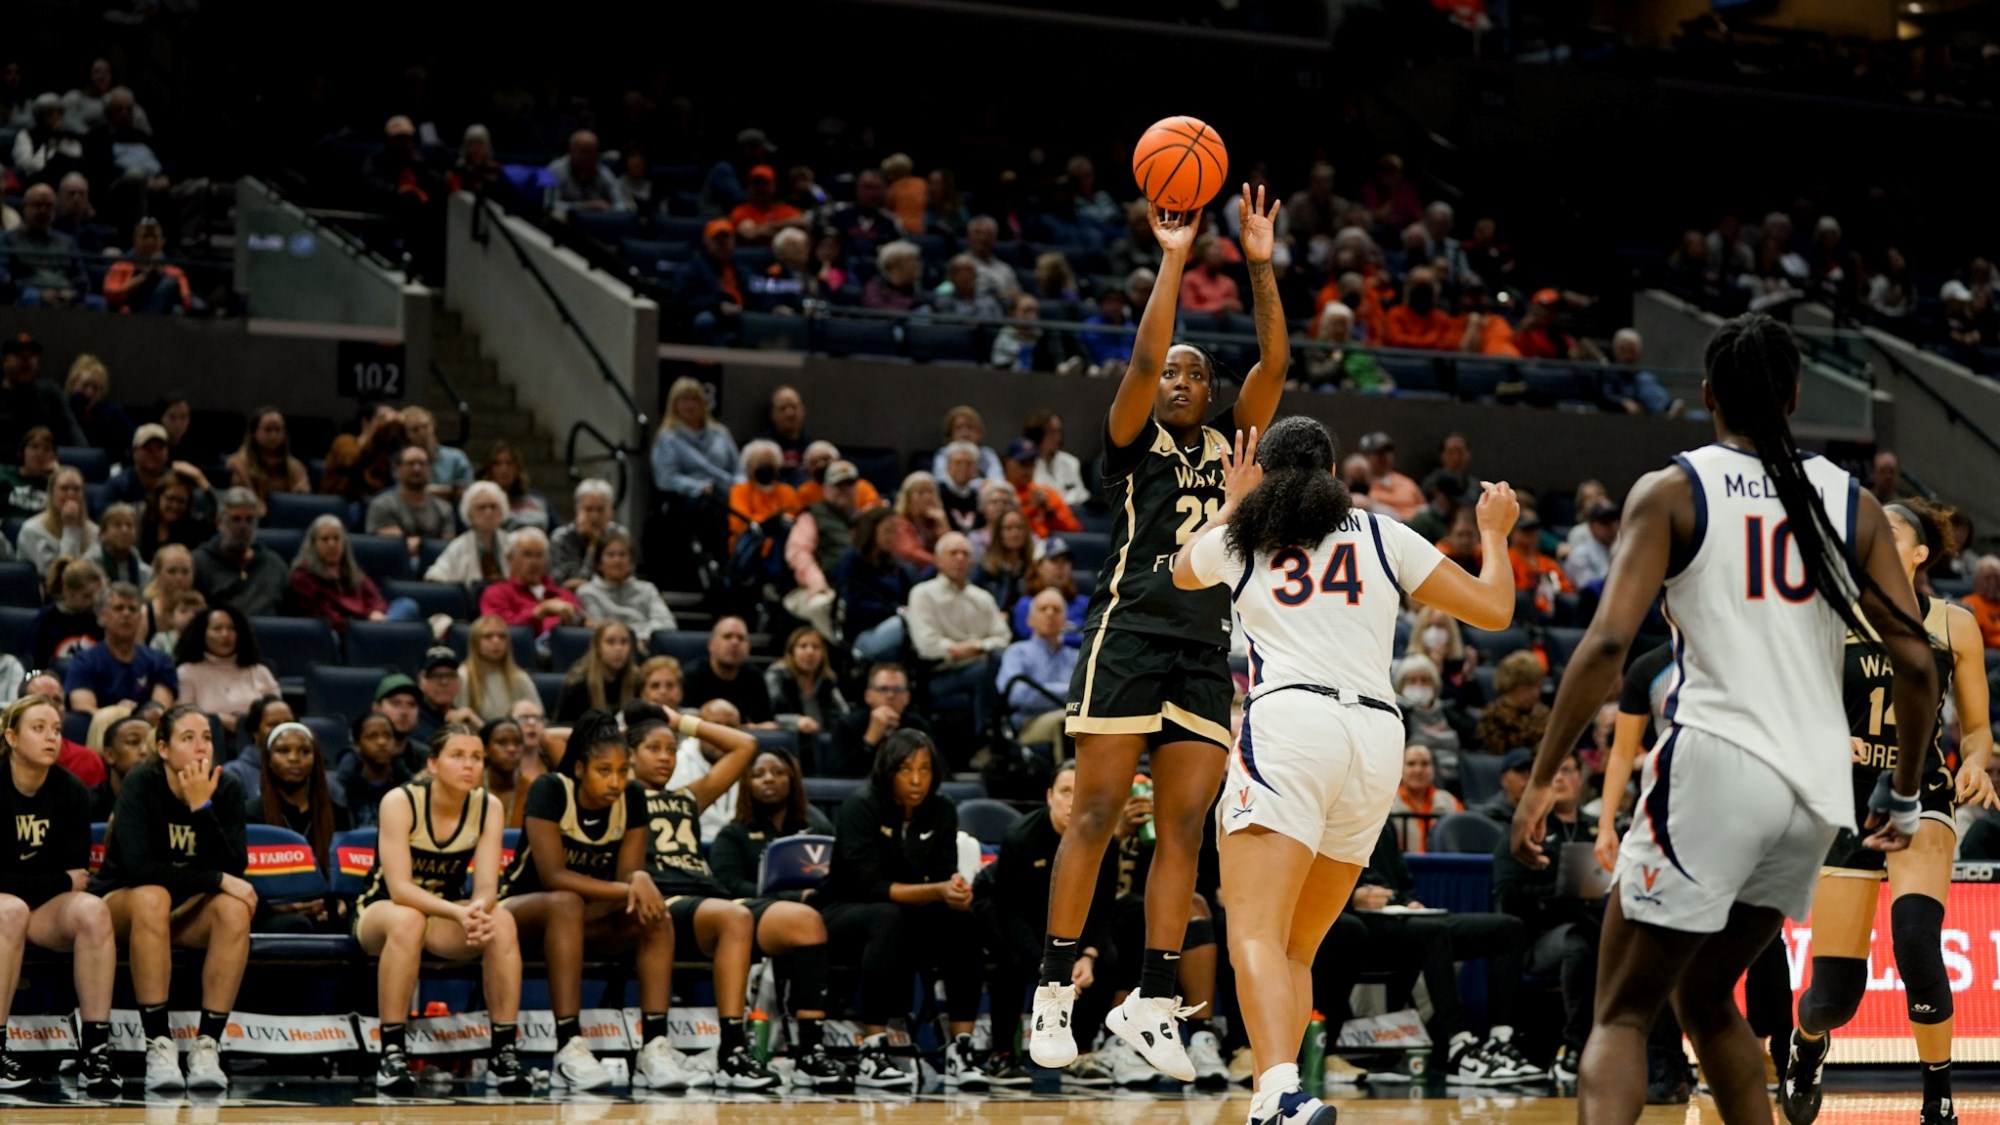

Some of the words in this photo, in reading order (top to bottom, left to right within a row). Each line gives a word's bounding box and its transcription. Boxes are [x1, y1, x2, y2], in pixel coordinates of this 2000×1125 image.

[353, 362, 400, 394] 102
[1270, 542, 1364, 607] 34
[1745, 515, 1818, 604] 10
[1860, 654, 1894, 679] WA
[16, 815, 49, 847] WF
[650, 817, 698, 854] 24
[260, 851, 305, 865] FARGO
[1952, 865, 1993, 881] EICO
